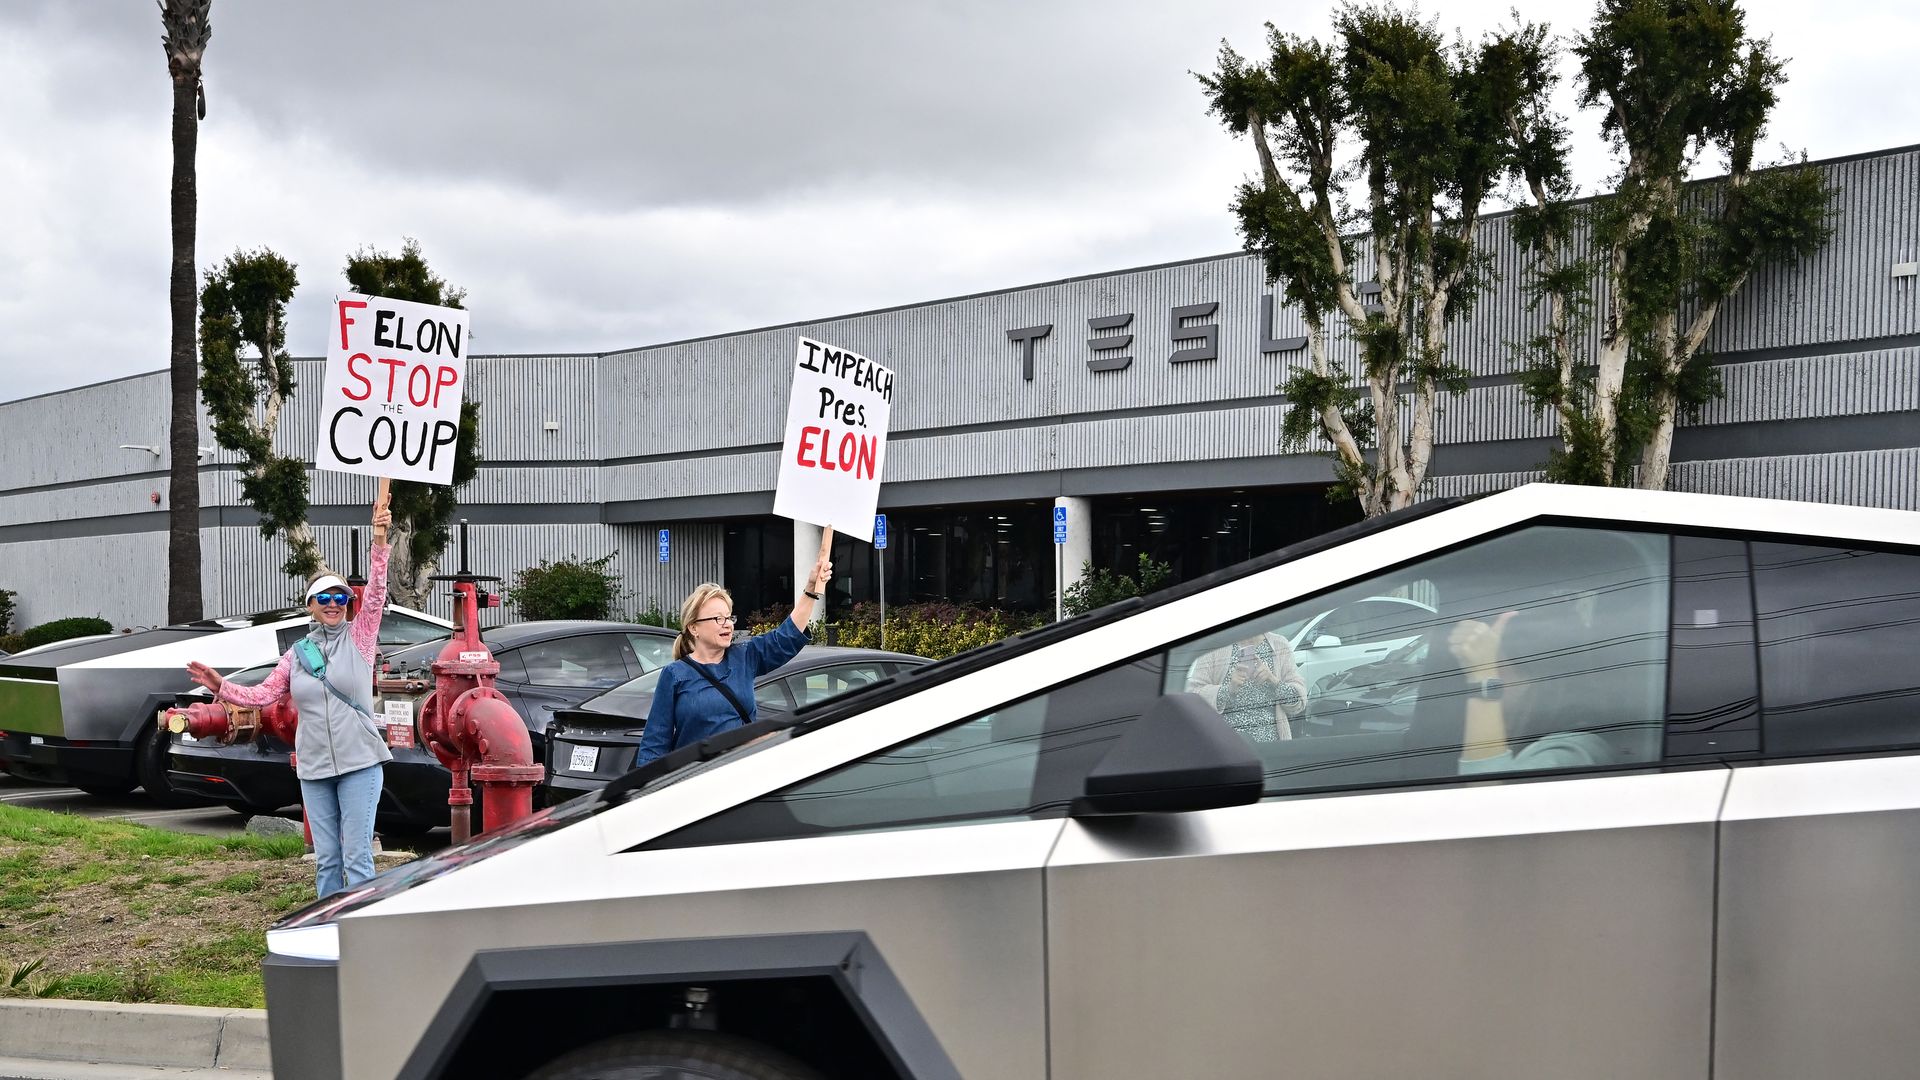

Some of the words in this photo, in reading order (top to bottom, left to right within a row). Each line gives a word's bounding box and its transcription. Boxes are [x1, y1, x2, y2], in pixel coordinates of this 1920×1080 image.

[341, 352, 458, 408] STOP
[799, 341, 893, 404] IMPEACH
[381, 403, 404, 414] THE
[819, 387, 867, 428] Pres.
[329, 406, 458, 471] COUP
[797, 426, 877, 480] ELON
